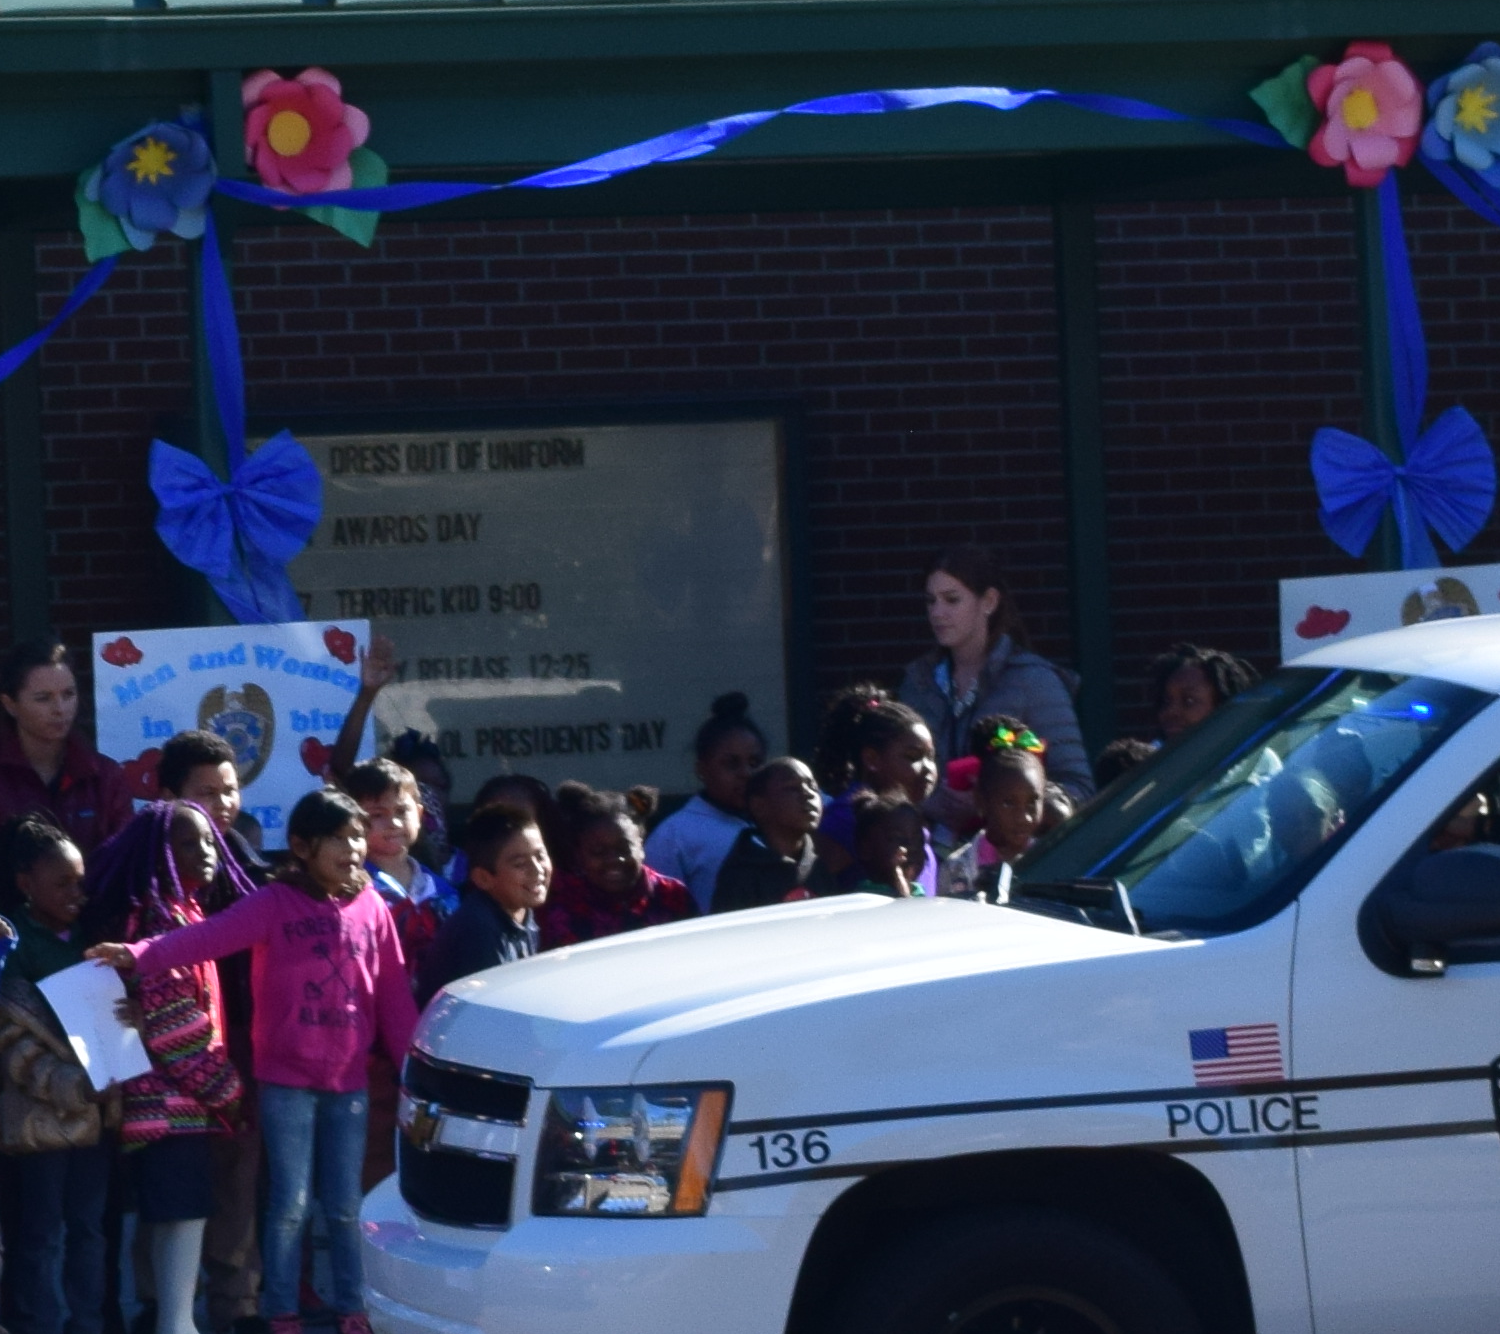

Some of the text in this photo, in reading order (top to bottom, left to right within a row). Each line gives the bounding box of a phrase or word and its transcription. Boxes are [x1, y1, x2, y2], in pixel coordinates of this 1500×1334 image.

[329, 438, 585, 475] DRESS OUT OF UNIFORM
[332, 513, 482, 546] AWARDS DAY
[336, 585, 436, 617] TERRIFIC
[441, 584, 480, 614] KID
[489, 582, 542, 613] 9:00
[111, 663, 177, 708] Men
[189, 642, 246, 672] and
[417, 655, 511, 680] RELEASE
[529, 653, 592, 679] 12:25
[289, 708, 348, 733] blu
[475, 723, 611, 758] PRESIDENTS
[620, 720, 668, 752] DAY
[1166, 1095, 1322, 1138] POLICE
[748, 1129, 831, 1170] 136
